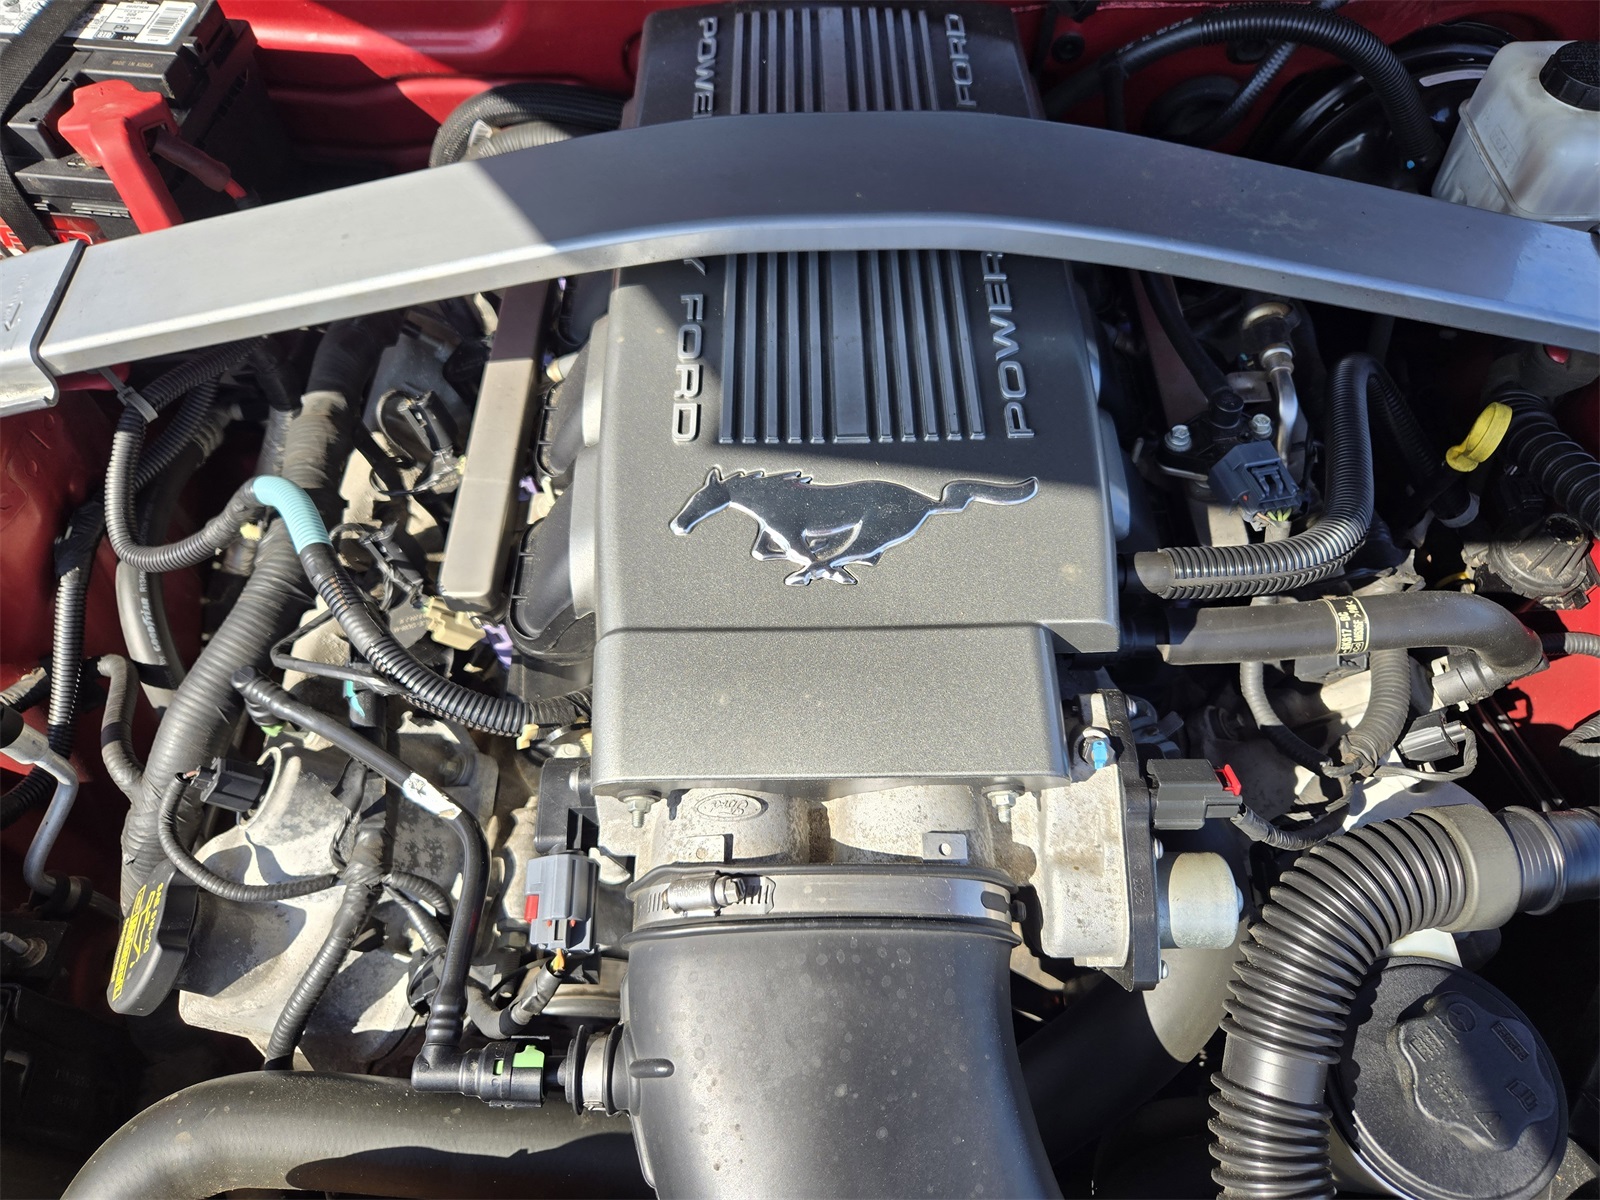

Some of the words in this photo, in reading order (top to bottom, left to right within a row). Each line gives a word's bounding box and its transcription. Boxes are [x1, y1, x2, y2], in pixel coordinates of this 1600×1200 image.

[693, 16, 718, 119] POWE
[944, 13, 977, 108] FORD
[672, 294, 704, 444] FORD
[980, 251, 1035, 439] POWER
[141, 597, 161, 653] GOODYEAR
[143, 909, 158, 954] 5W-20
[153, 882, 164, 909] SAE
